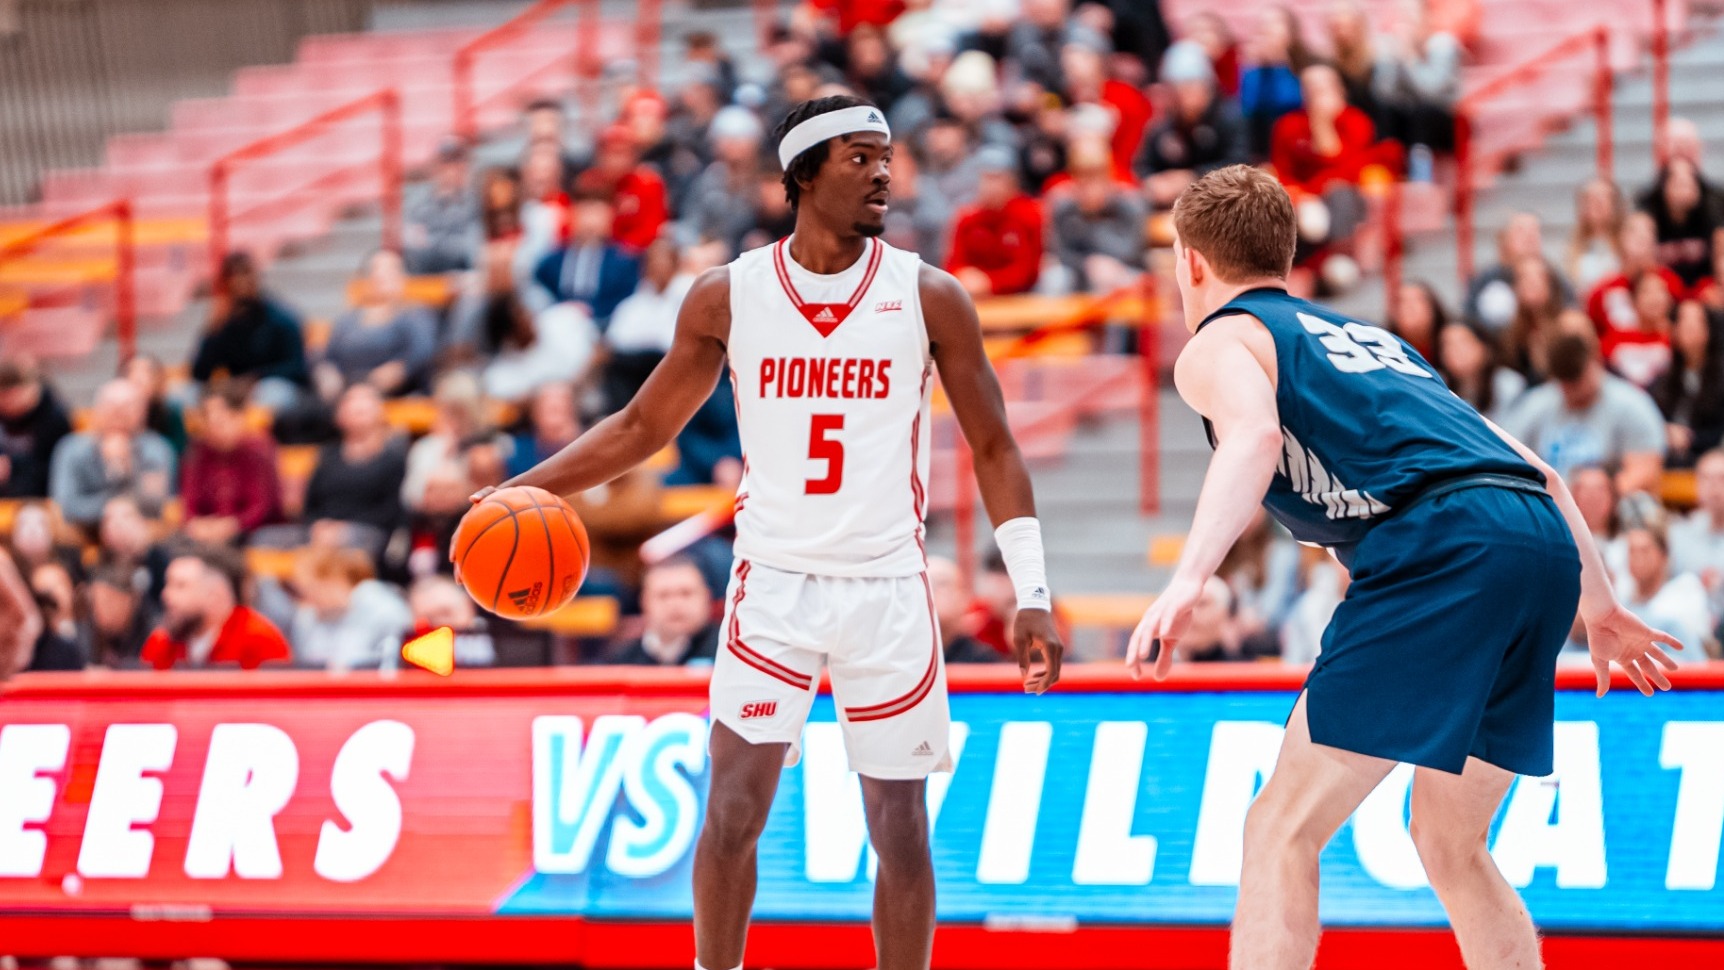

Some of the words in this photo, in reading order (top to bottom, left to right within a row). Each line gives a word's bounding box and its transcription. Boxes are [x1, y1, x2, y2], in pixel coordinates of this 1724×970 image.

[759, 357, 892, 399] PIONEERS
[804, 413, 845, 495] 5
[740, 701, 777, 719] SHU
[0, 719, 416, 882] EERS
[532, 712, 708, 878] VS
